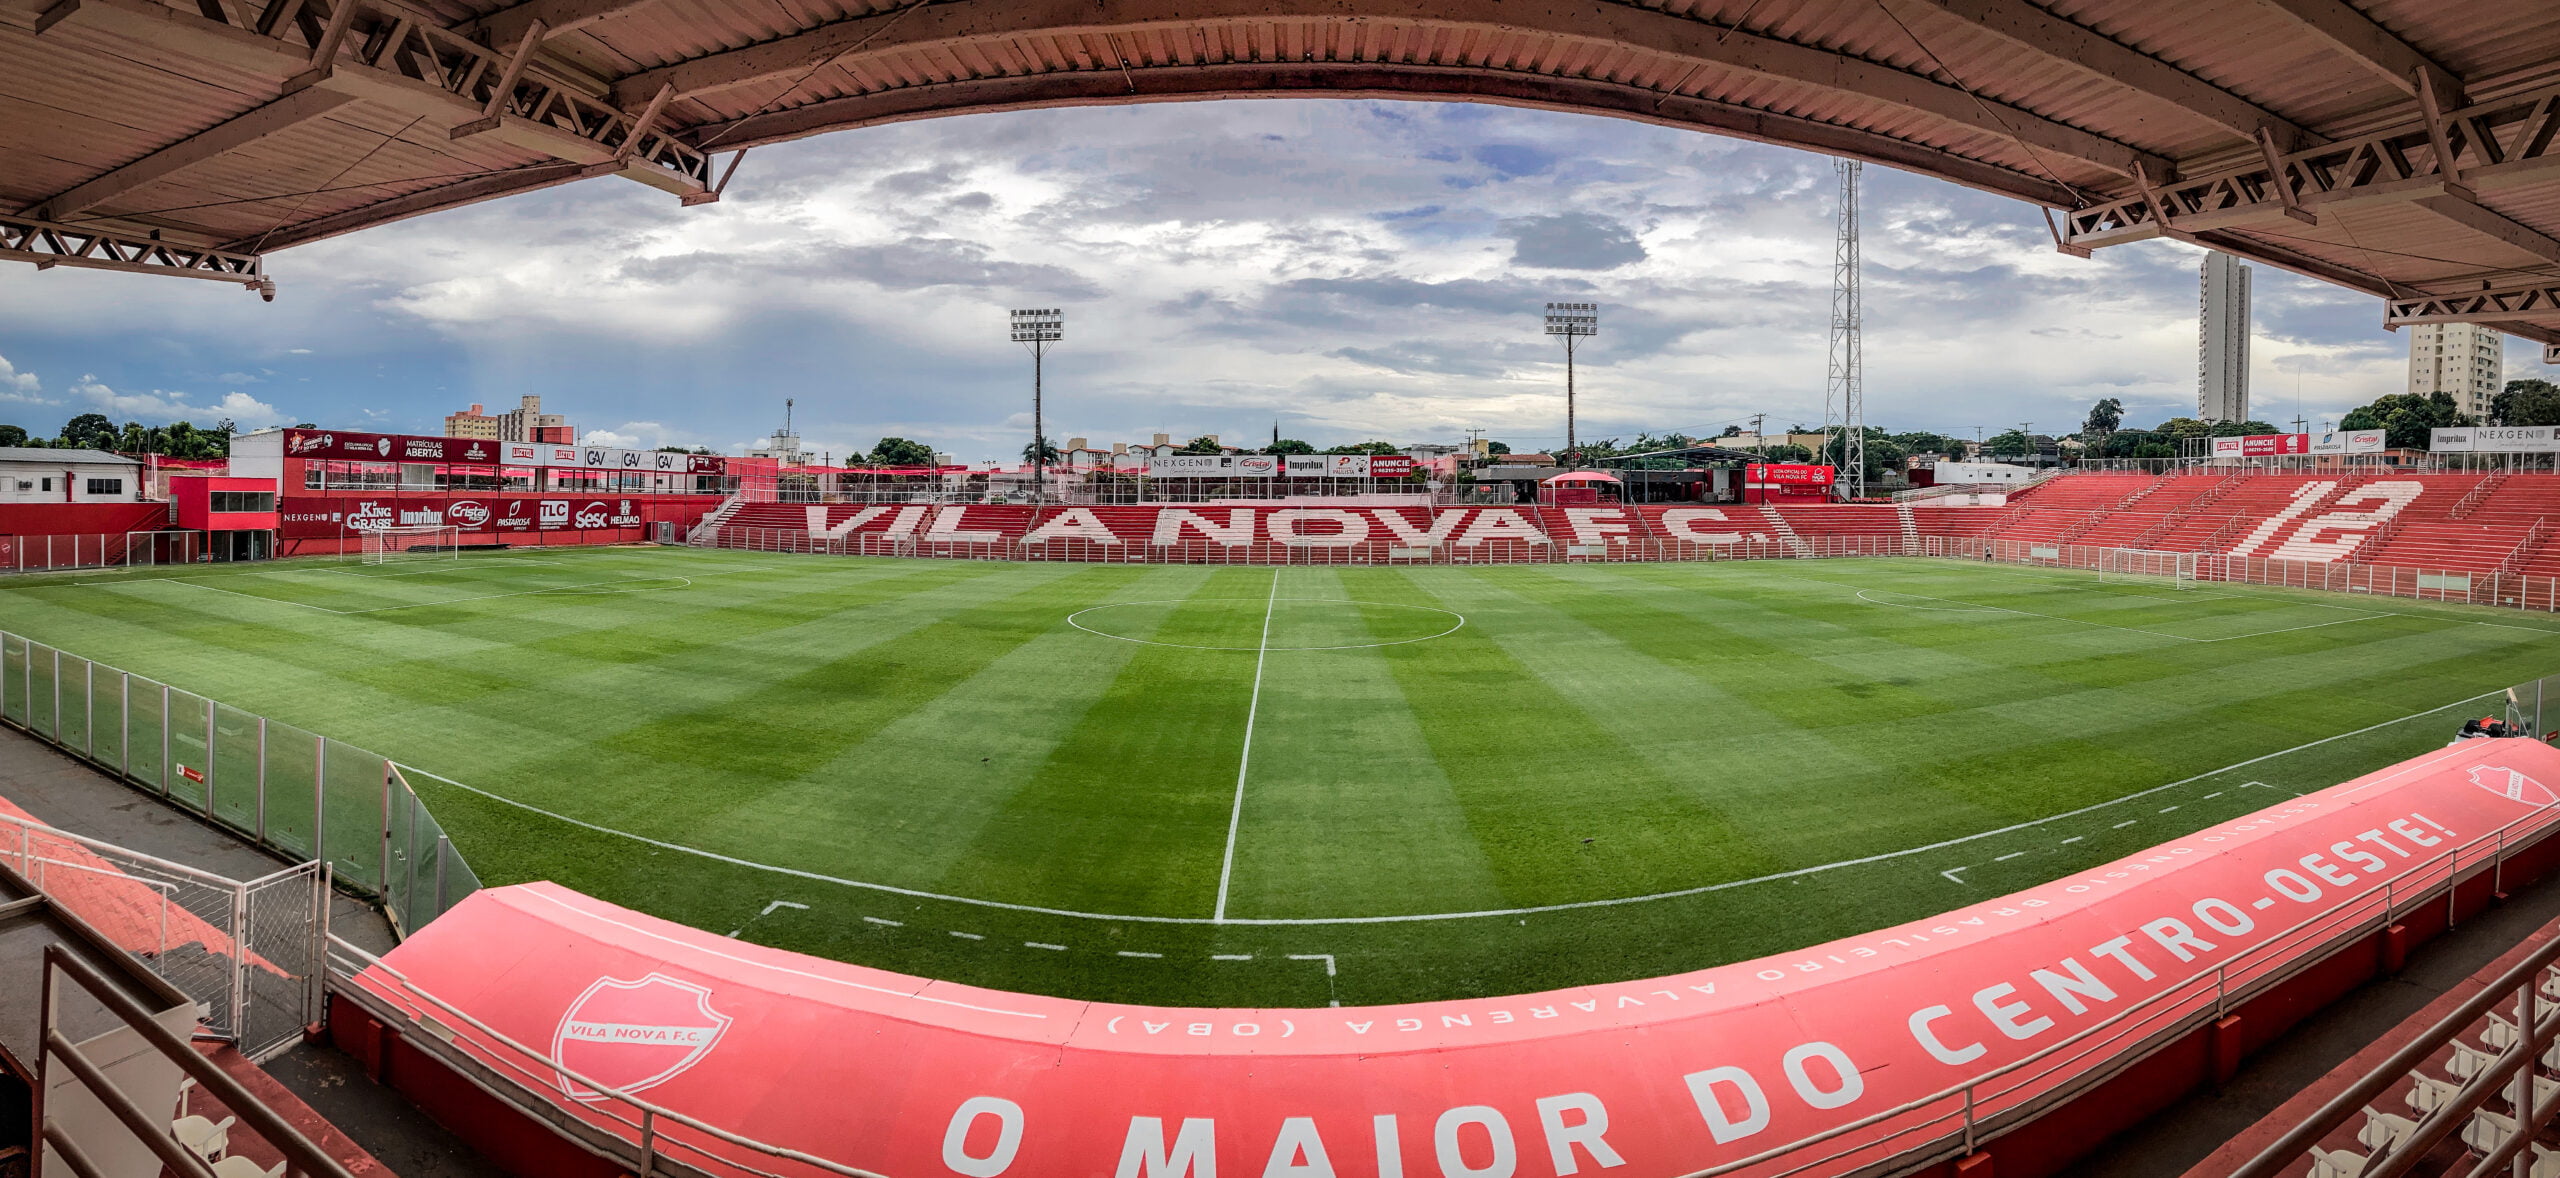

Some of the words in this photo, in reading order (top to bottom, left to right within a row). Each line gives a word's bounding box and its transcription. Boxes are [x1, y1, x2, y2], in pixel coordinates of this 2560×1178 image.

[2437, 435, 2467, 444] Imprilux
[2479, 430, 2534, 440] NEXGEN
[406, 440, 443, 449] MATRÍCULAS
[2244, 439, 2274, 447] ANUNCIE
[405, 448, 443, 458] ABERTAS
[587, 450, 605, 465] GAV
[623, 453, 640, 467] GAV
[658, 455, 673, 469] GAV
[1153, 459, 1203, 467] NEXGEN
[1289, 460, 1323, 471] Imprilux
[1372, 459, 1410, 467] ANUNCIE
[359, 500, 392, 517] KING
[451, 506, 488, 517] Cristal
[541, 503, 566, 516] TLC
[284, 513, 322, 521] NEXGEN
[346, 512, 392, 530] GRASS
[2227, 480, 2424, 563] 12
[806, 504, 1124, 545] VILA
[1151, 508, 1552, 547] NOVA
[1756, 898, 2050, 981] BRASILEIRO
[1113, 1092, 1626, 1178] MAIOR
[1684, 1041, 1865, 1145] DO
[1907, 812, 2457, 1066] CENTRO-OESTE!
[1346, 982, 1716, 1034] ALVARENGA
[570, 1025, 608, 1038] VILA
[614, 1028, 667, 1041] NOVA
[672, 1031, 701, 1042] F.C.
[1107, 1015, 1296, 1039] (OBA)
